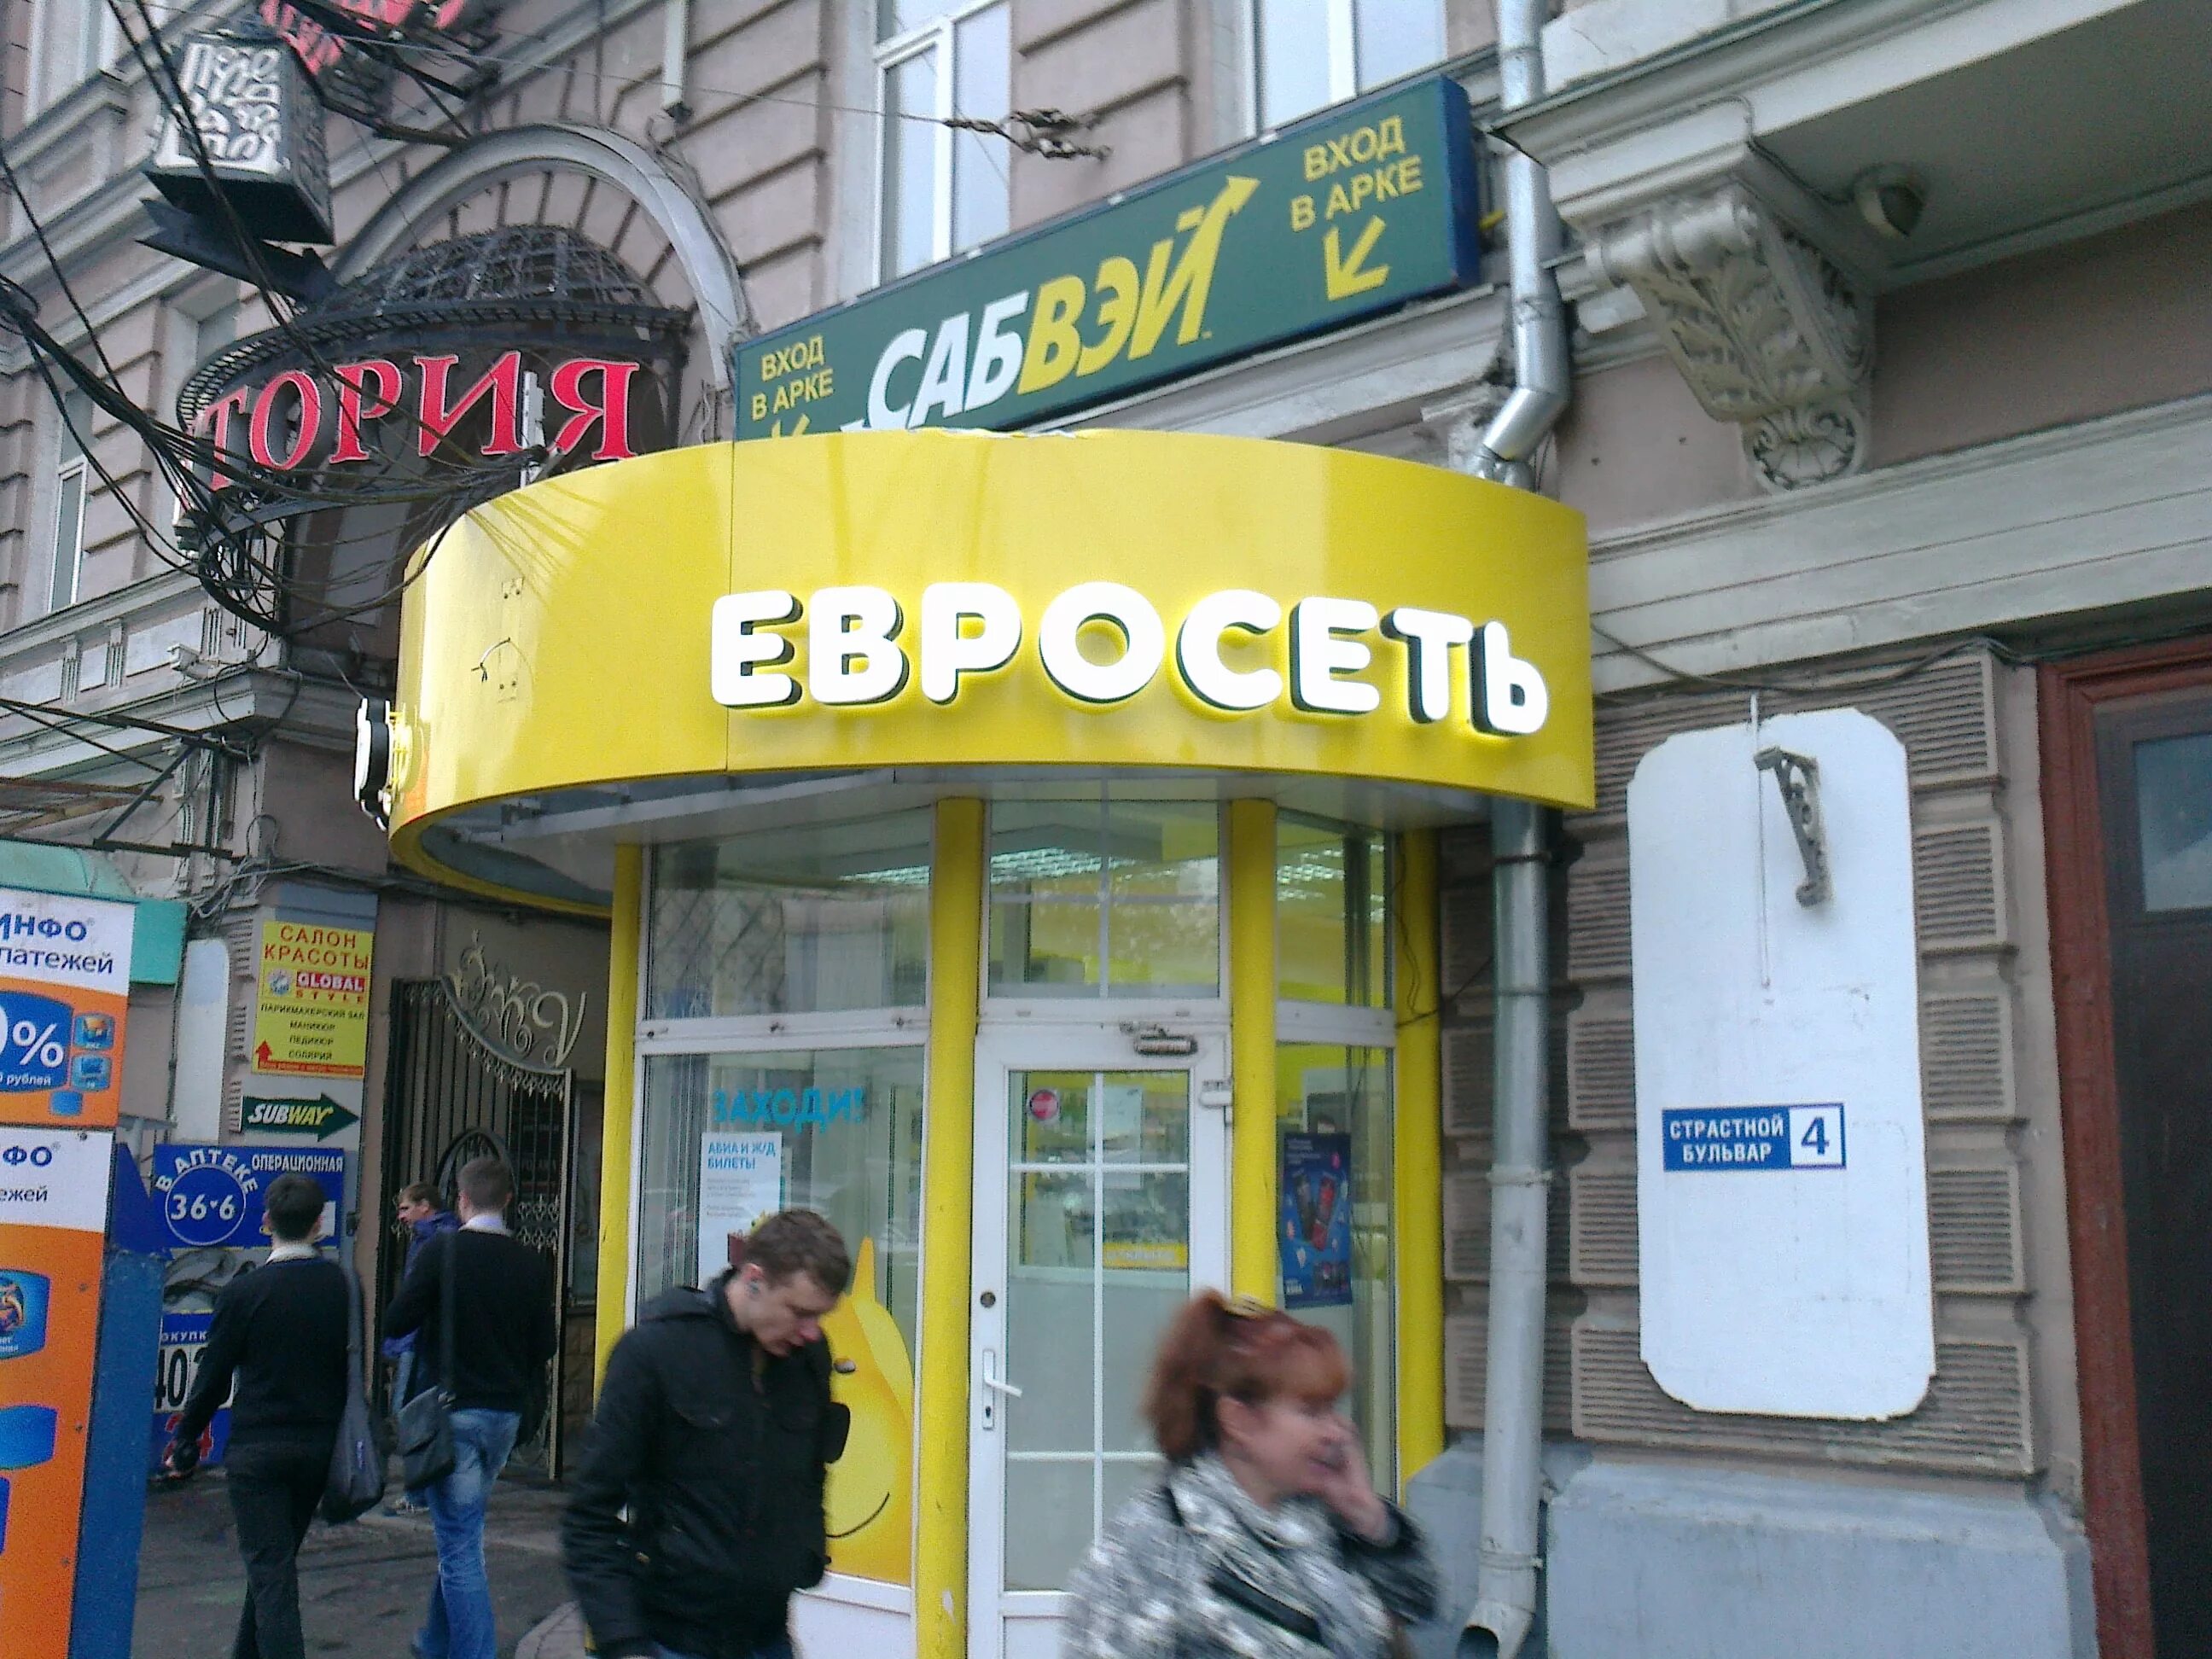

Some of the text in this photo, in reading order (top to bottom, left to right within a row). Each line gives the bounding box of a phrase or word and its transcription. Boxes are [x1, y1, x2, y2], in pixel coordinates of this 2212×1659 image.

[1304, 114, 1406, 183] ВХОД
[1290, 154, 1423, 232] В АРКЕ
[843, 178, 1258, 430] САБВЭЙ
[760, 335, 825, 382] ВХОД
[751, 368, 835, 422] В АРКЕ
[711, 581, 1551, 740] ЕВРОСЕТЬ
[280, 924, 357, 949] САЛОН
[264, 943, 370, 970] КРАСОТЫ
[296, 988, 364, 1004] STYLE
[297, 971, 364, 992] GLOBAL
[247, 1103, 334, 1126] SUBWAY
[713, 1087, 864, 1135] ЗАХОДИ!
[708, 1142, 740, 1155] АВИА
[1670, 1114, 1830, 1155] СТРАСТНОЙ 4
[251, 1154, 343, 1173] ОПЕРАЦИОННАЯ
[707, 1157, 755, 1170] БИЛЕТЫ
[1683, 1143, 1772, 1163] БУЛЬВАР
[155, 1148, 259, 1195] В АПТЕКЕ
